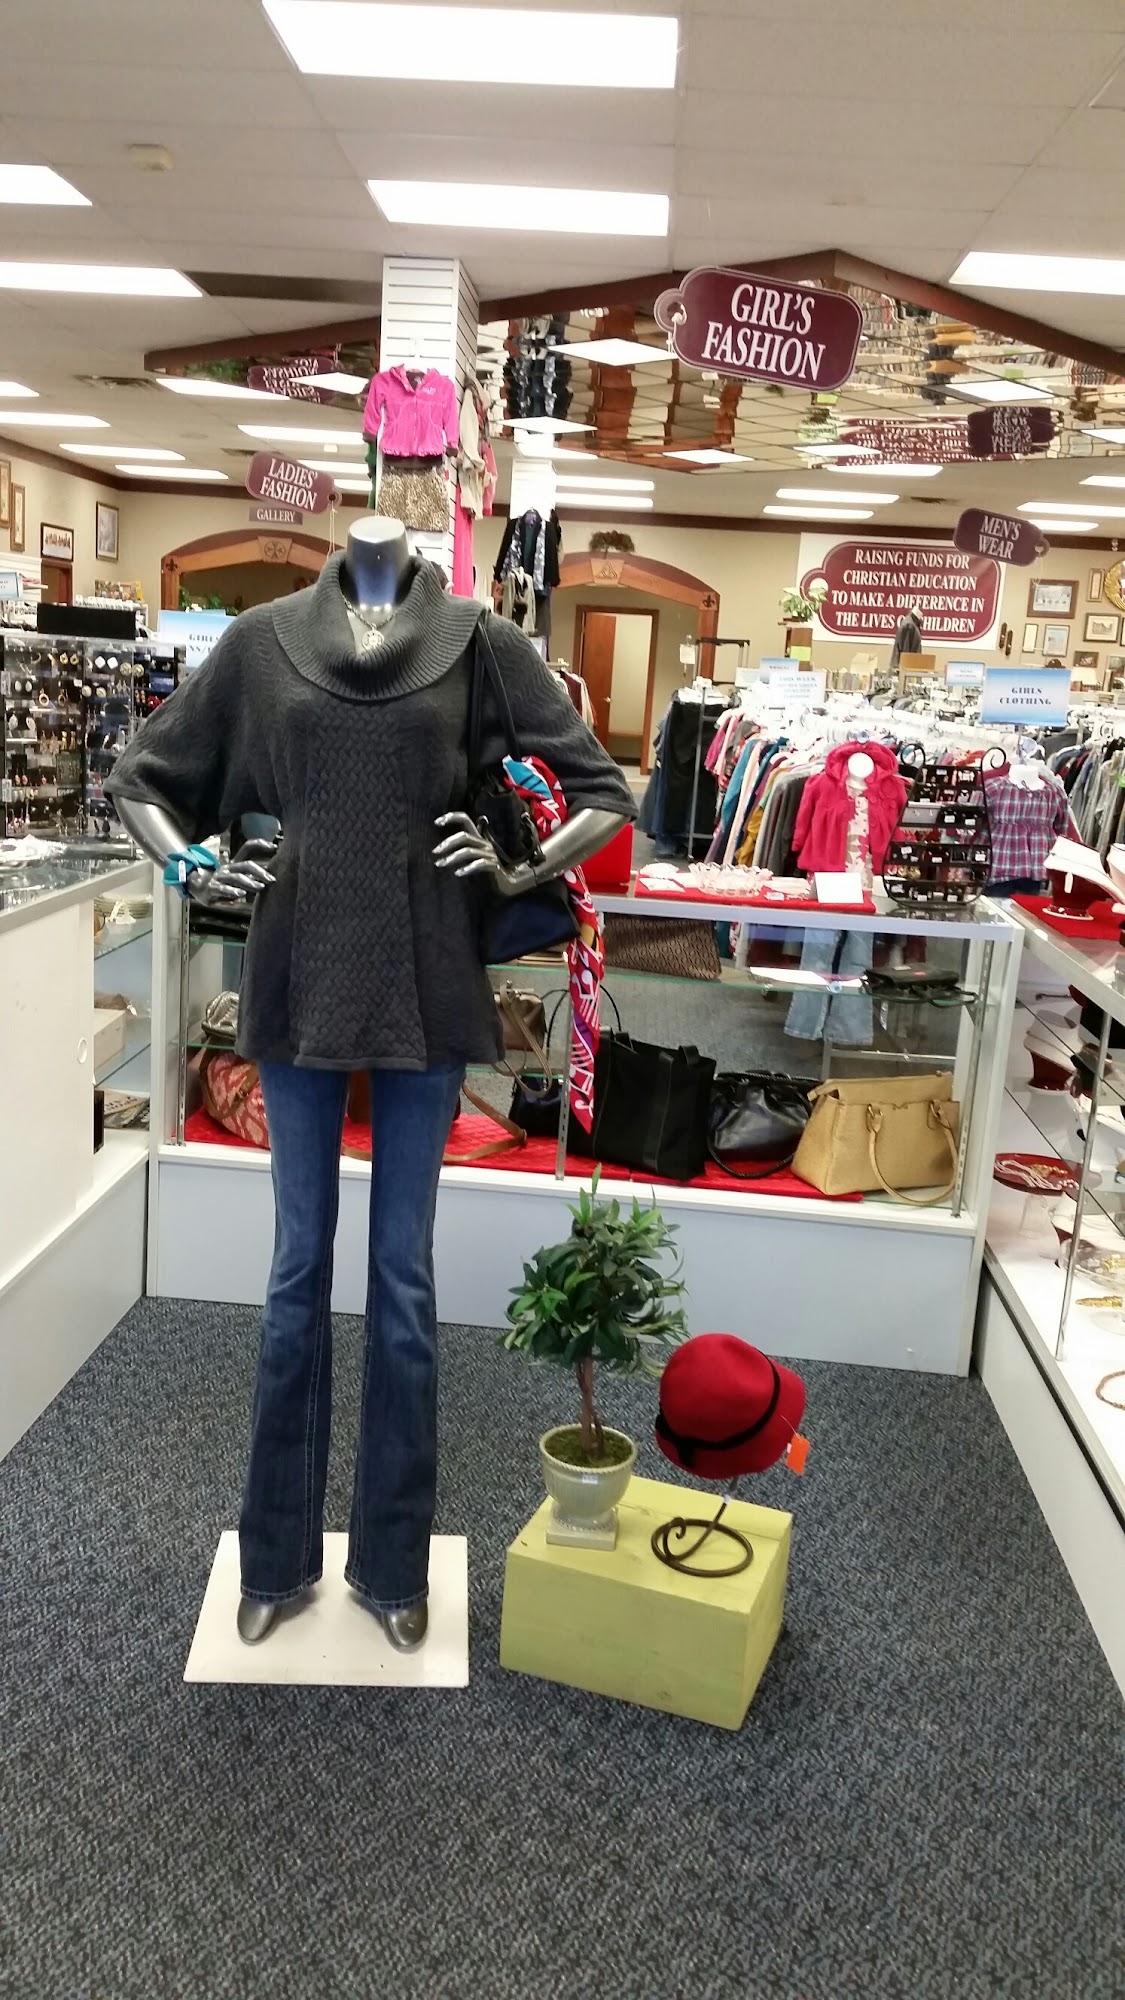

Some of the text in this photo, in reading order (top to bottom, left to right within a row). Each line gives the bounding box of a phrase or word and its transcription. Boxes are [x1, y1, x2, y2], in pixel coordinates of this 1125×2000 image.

[731, 283, 815, 335] GIRL'S
[701, 321, 826, 381] FASHION
[268, 458, 318, 489] LADIES'
[260, 476, 317, 511] FASHION
[256, 508, 295, 522] GALLERY
[980, 515, 1021, 540] MEN'S
[978, 533, 1014, 559] WEAR
[855, 549, 969, 569] RAISING FUNDS FOR
[843, 569, 977, 591] CHRISTIAN EDUCATION
[832, 590, 985, 613] TO MAKE A DIFFERENCE IN
[836, 611, 859, 627] THE
[861, 612, 895, 629] LIVES
[999, 697, 1052, 705] CLOTHING
